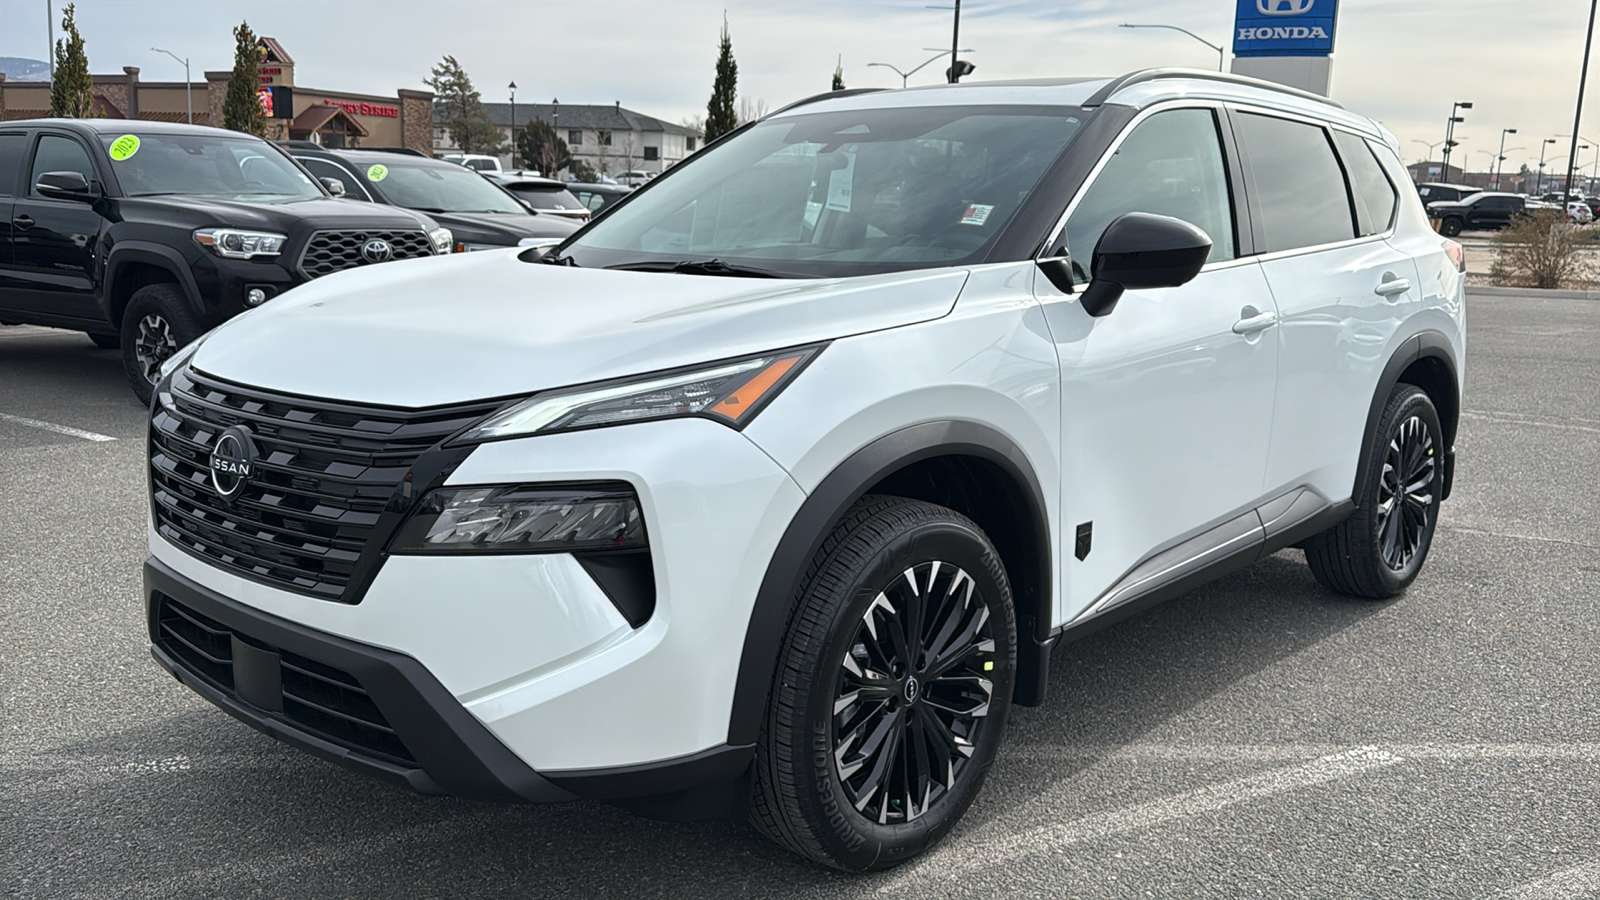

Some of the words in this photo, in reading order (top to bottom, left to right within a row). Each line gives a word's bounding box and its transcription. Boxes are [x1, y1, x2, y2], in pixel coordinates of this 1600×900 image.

[1237, 26, 1329, 40] HONDA
[324, 99, 360, 114] CKY
[361, 102, 399, 117] STRIKE
[114, 137, 135, 157] 2023
[213, 458, 249, 475] SSAN
[812, 719, 867, 852] BRIDGESTONE
